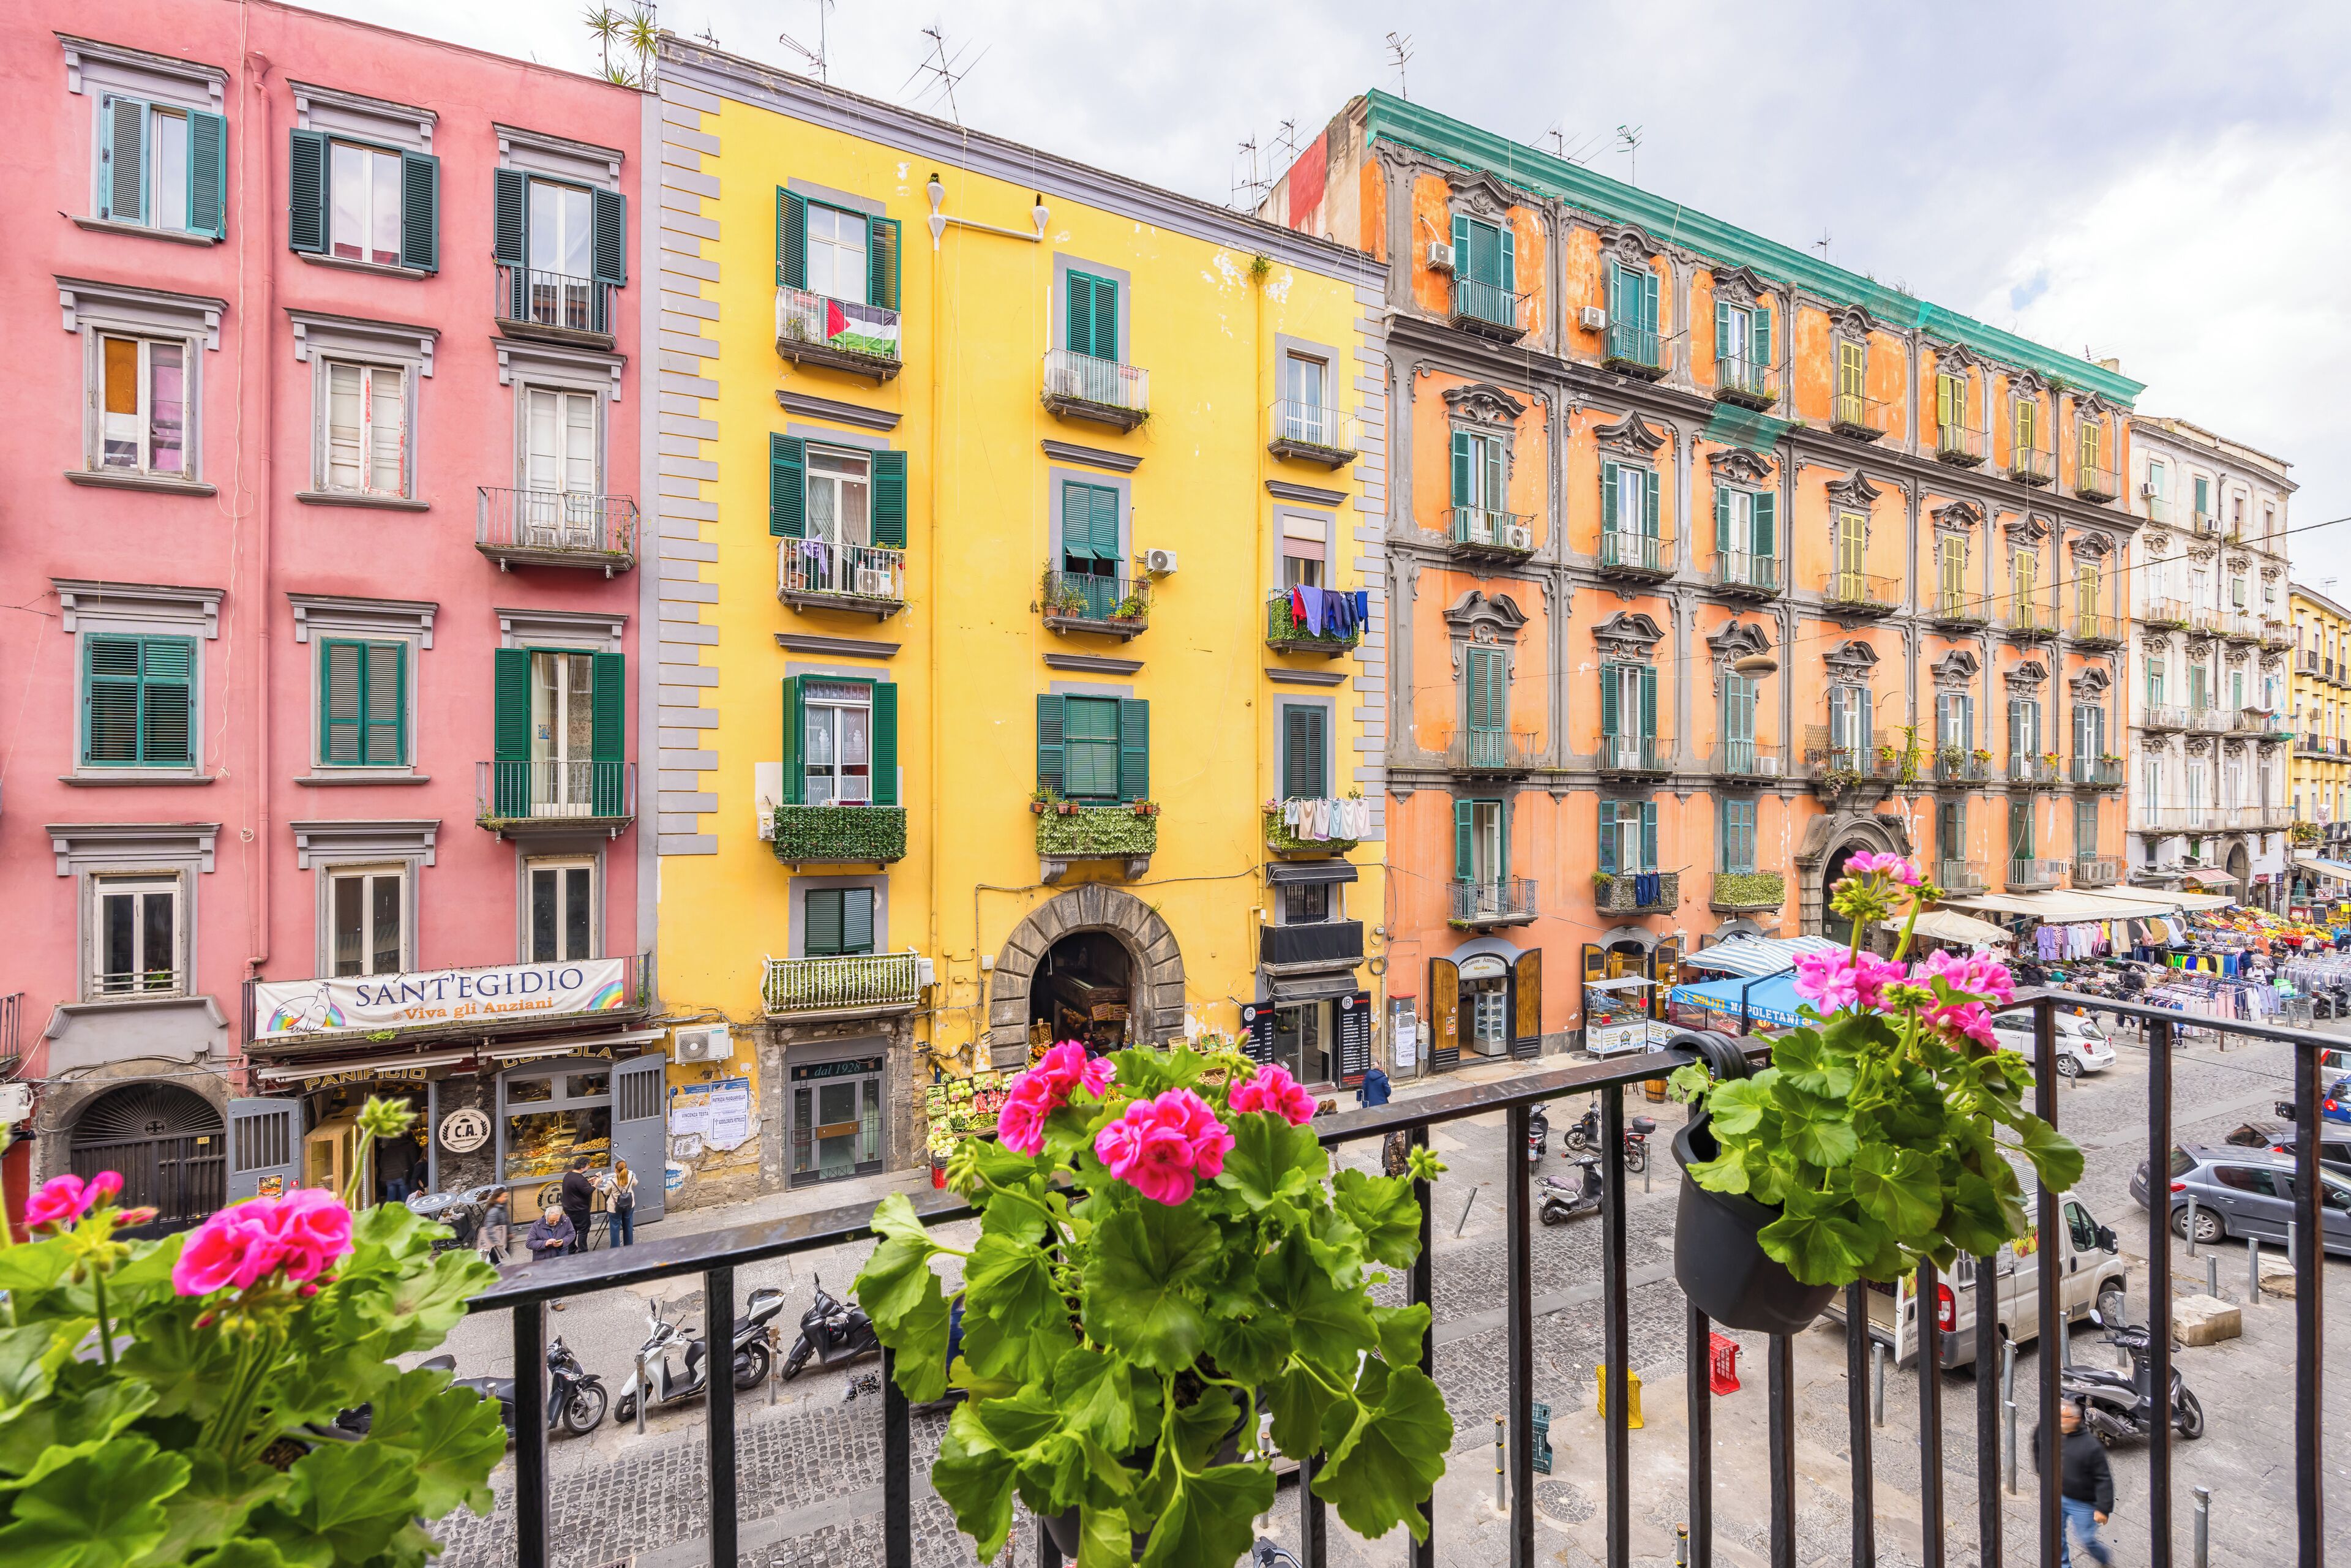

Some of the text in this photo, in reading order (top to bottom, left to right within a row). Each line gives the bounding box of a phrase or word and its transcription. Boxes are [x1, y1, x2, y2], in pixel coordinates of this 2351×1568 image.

[1461, 957, 1502, 970] Salvatore Amoroso
[356, 968, 583, 1007] SANT'EGIDIO
[403, 996, 553, 1020] Viva gli Anziani
[1692, 994, 1725, 1009] SOLITI
[502, 1046, 612, 1068] COLA
[814, 1062, 861, 1076] dal 1928
[304, 1067, 427, 1092] PANIFICIO
[455, 1123, 478, 1138] C.A.
